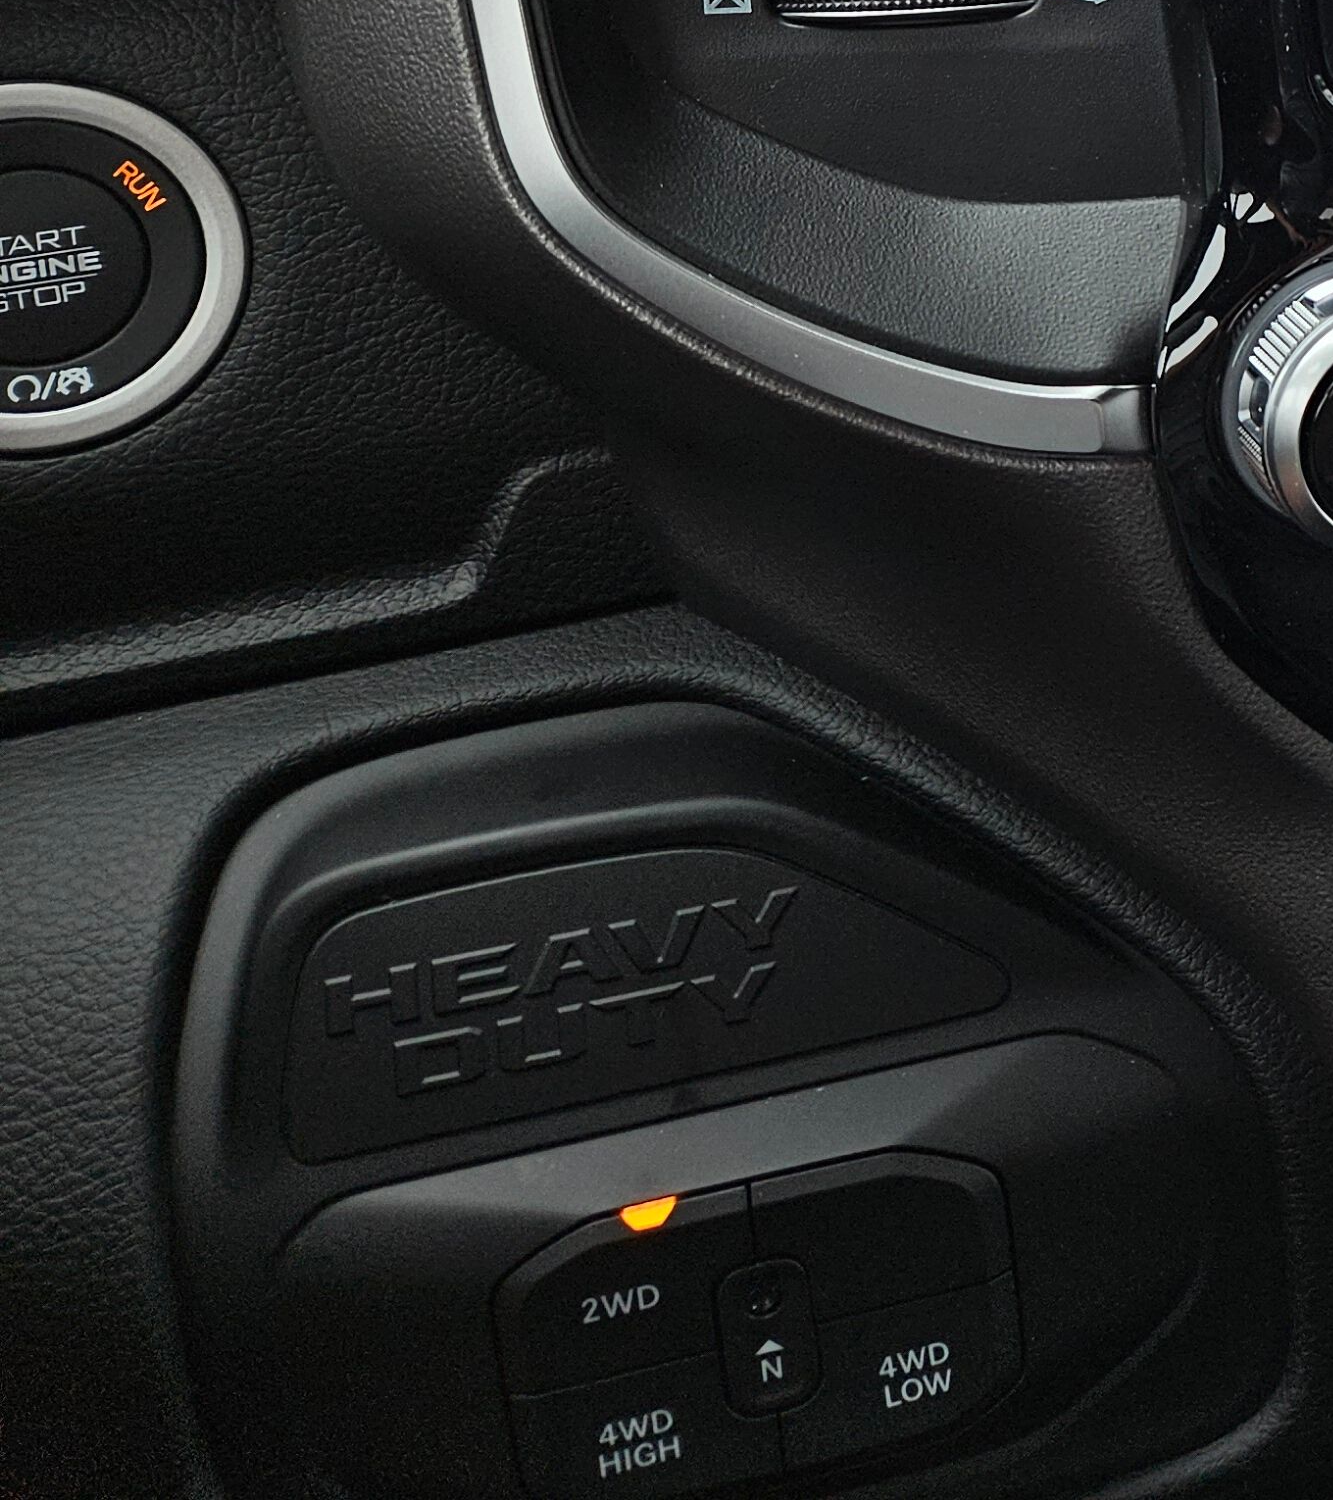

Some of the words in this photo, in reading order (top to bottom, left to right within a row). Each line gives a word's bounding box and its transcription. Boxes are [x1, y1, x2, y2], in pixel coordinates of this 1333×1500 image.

[112, 160, 167, 212] RUN
[324, 886, 798, 1037] HEAVY
[394, 961, 777, 1098] DUTY
[581, 1284, 661, 1324] 2WD
[761, 1356, 784, 1383] N
[878, 1341, 950, 1380] 4WD
[884, 1369, 952, 1409] LOW
[598, 1409, 674, 1447] 4WD
[598, 1436, 682, 1479] HIGH
